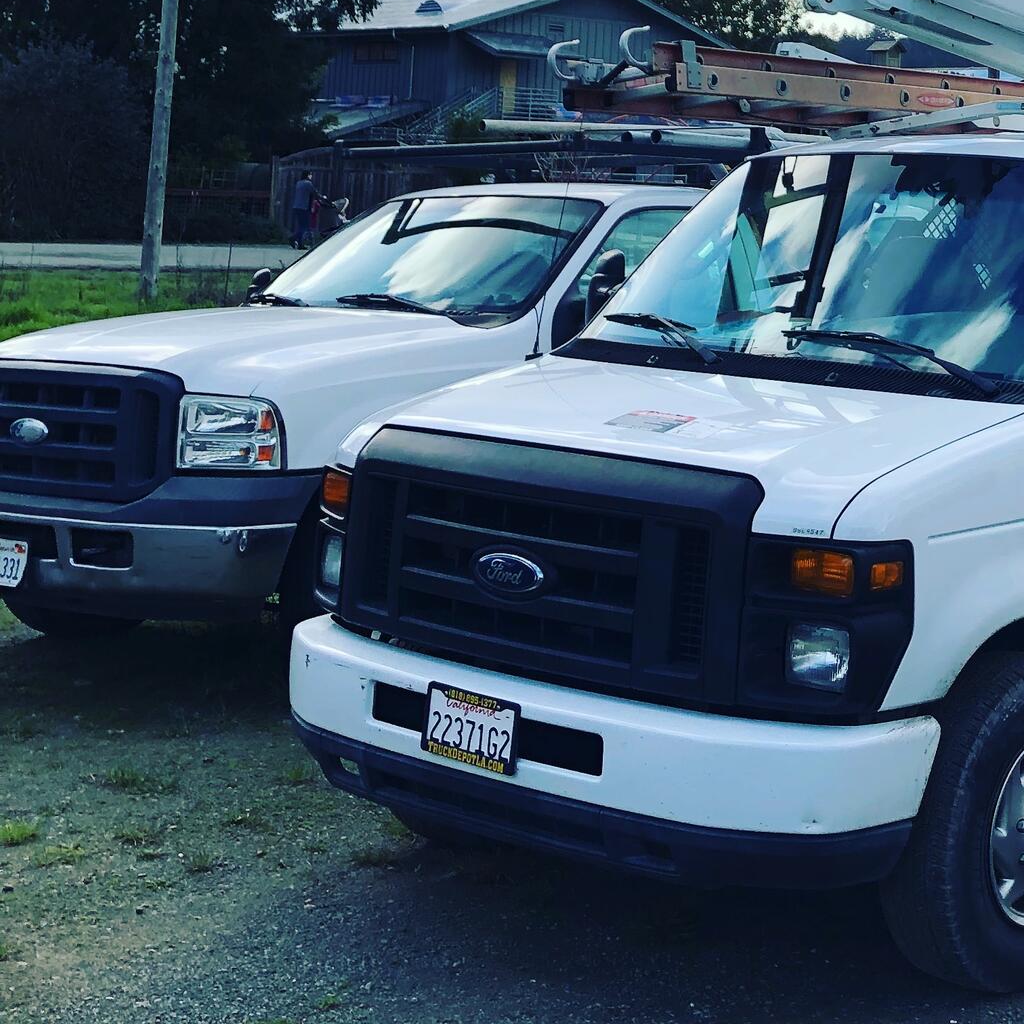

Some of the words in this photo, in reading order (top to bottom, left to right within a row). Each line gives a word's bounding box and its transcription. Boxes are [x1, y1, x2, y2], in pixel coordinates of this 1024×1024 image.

[486, 558, 524, 585] Ford
[429, 710, 510, 764] 22371G2
[427, 740, 504, 774] TRUCKDEPOTLA.COM
